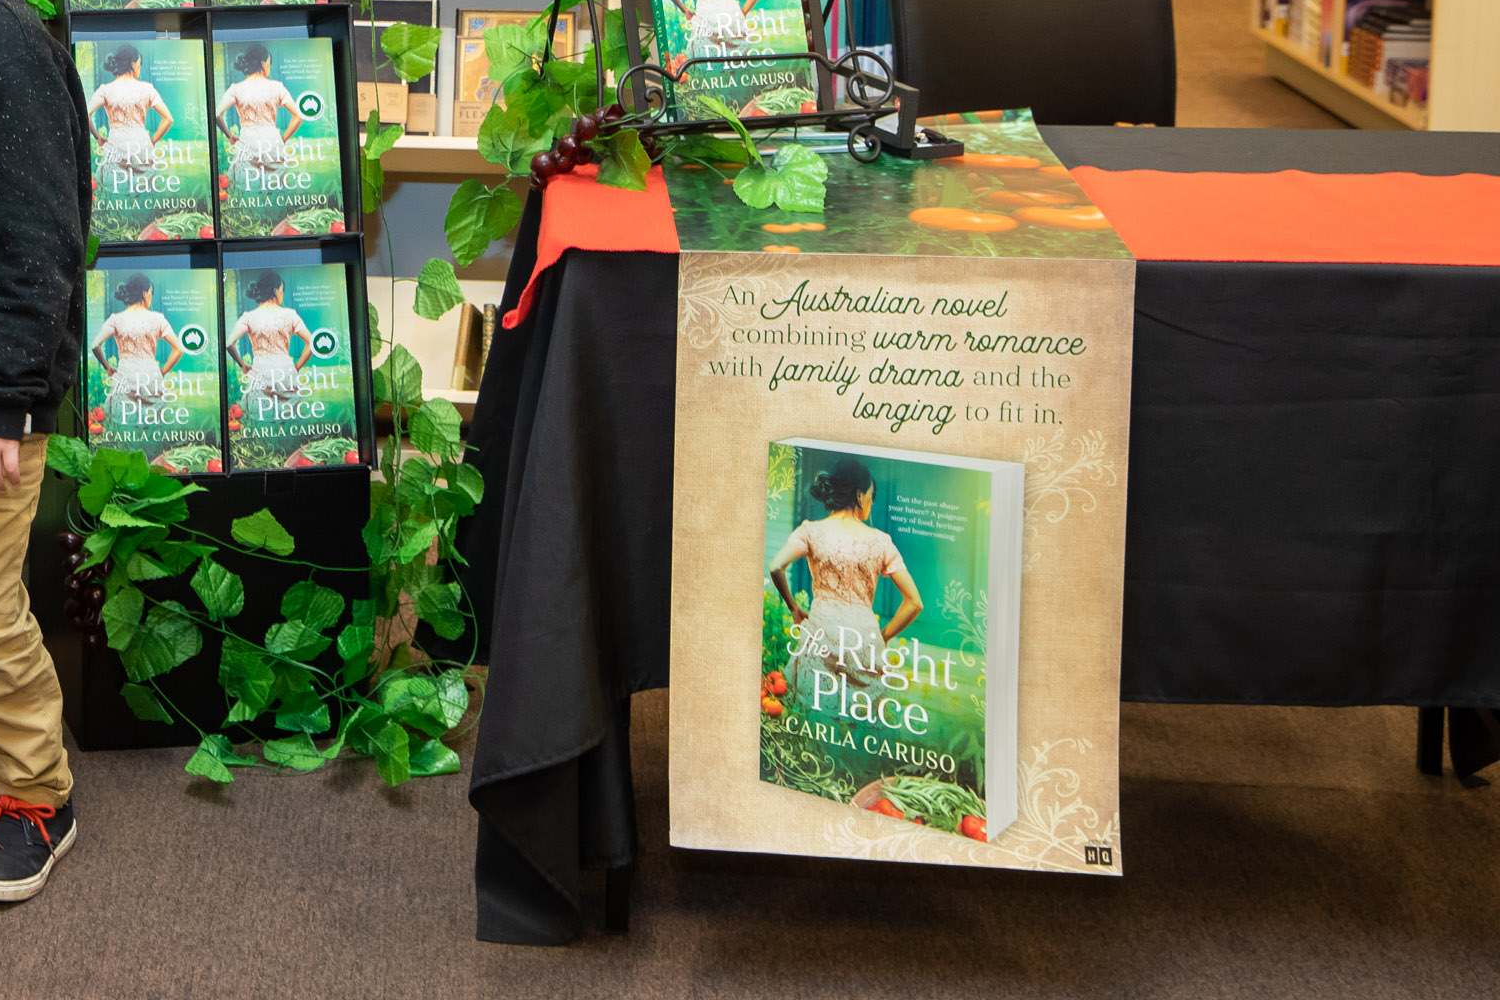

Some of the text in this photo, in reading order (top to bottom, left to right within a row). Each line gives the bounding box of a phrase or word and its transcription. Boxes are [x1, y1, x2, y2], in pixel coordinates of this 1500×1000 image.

[716, 8, 789, 44] Right
[691, 71, 795, 90] CARLA CARUSO
[125, 138, 195, 171] Right
[257, 136, 325, 168] Right
[112, 167, 180, 194] Place
[244, 166, 311, 192] Place
[97, 197, 196, 210] CARLA CARUSO
[230, 194, 327, 209] CARLA CARUSO
[720, 279, 1008, 320] An Australian novel
[732, 323, 1087, 355] combining warm romance
[134, 370, 205, 403] Right
[270, 364, 339, 397] Right
[708, 355, 1071, 396] with family drama and the
[121, 398, 189, 425] Place
[257, 394, 325, 421] Place
[852, 392, 1063, 435] longing to fit in.
[105, 430, 205, 442] CARLA CARUSO
[243, 423, 341, 439] CARLA CARUSO
[786, 624, 958, 691] The Right
[811, 668, 929, 735] Place
[786, 716, 956, 774] CARLA CARUSO
